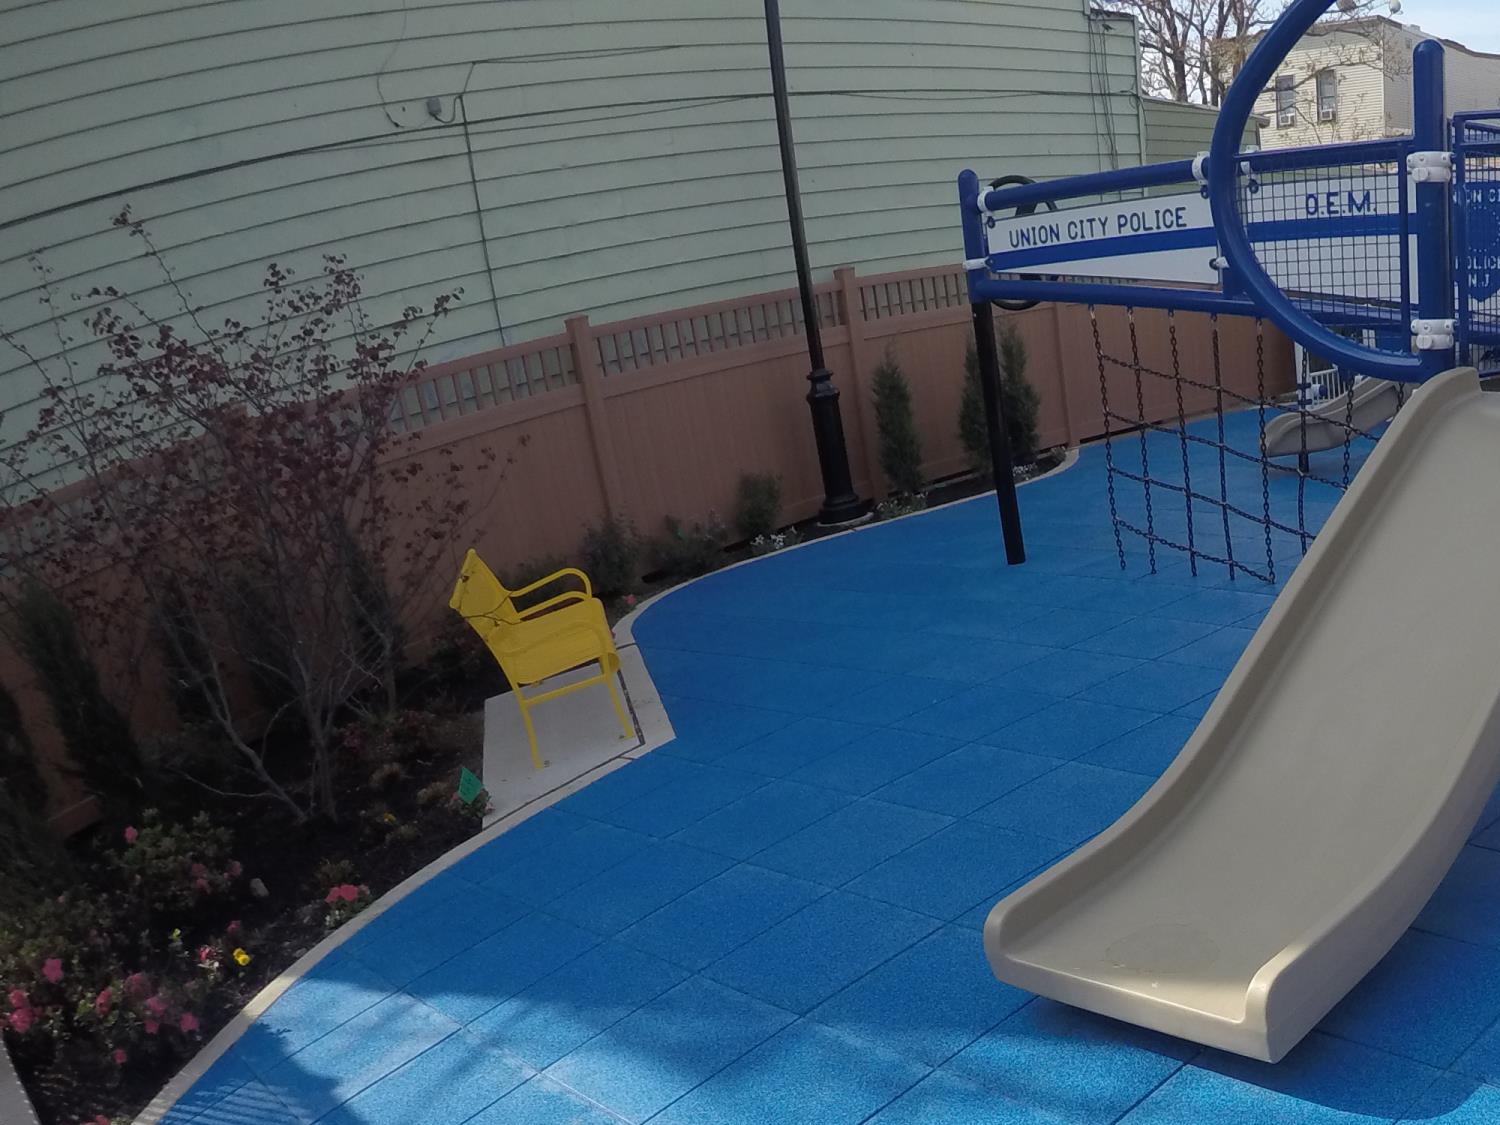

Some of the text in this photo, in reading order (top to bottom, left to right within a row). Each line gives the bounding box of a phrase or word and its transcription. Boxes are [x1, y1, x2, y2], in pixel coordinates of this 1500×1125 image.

[1009, 206, 1187, 249] UNION CITY POLICE
